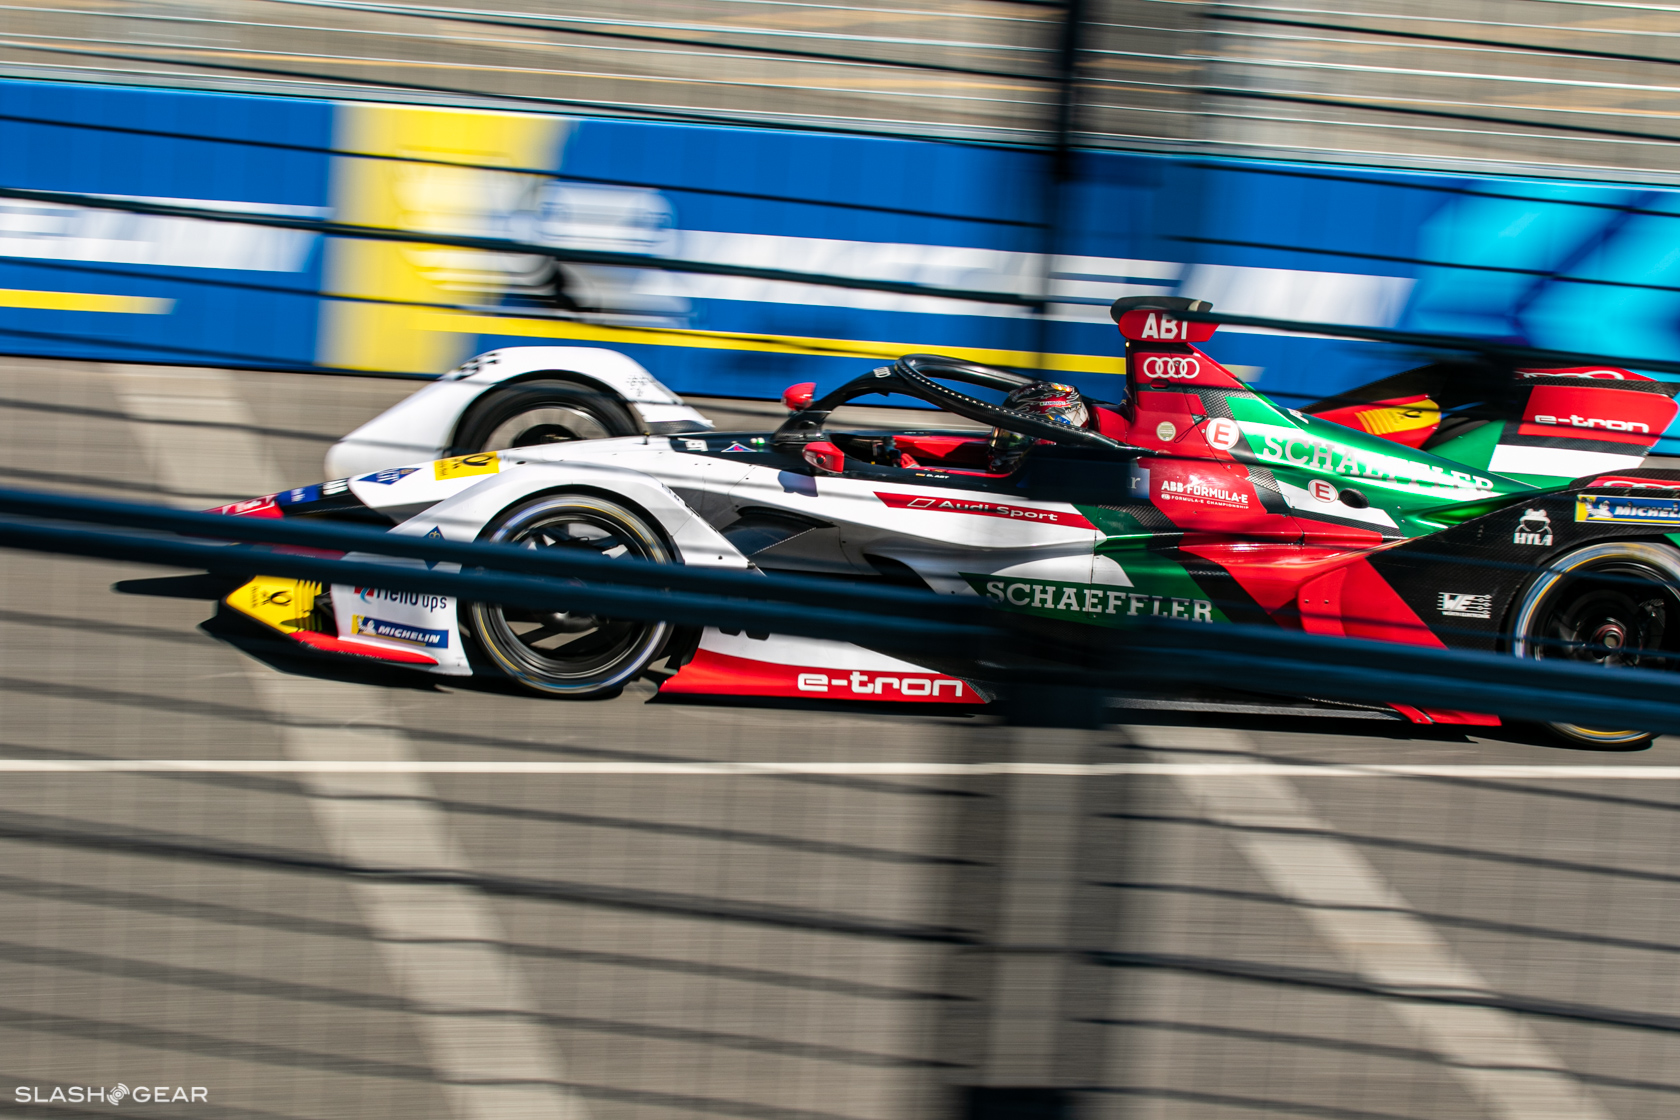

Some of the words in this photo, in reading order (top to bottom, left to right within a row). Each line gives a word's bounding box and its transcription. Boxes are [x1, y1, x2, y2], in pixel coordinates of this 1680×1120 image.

[1534, 414, 1650, 433] e-tron
[1213, 423, 1232, 445] E
[1262, 435, 1494, 493] SCHAELER
[1161, 480, 1184, 493] ABB
[1315, 482, 1331, 500] E
[938, 500, 989, 512] Audi
[996, 506, 1058, 521] Sport
[1613, 505, 1680, 518] MICHEL
[1512, 532, 1553, 546] HYLA
[986, 581, 1213, 624] SCHAEFFLER
[377, 625, 441, 644] MICHELIN
[797, 671, 963, 697] e-tron
